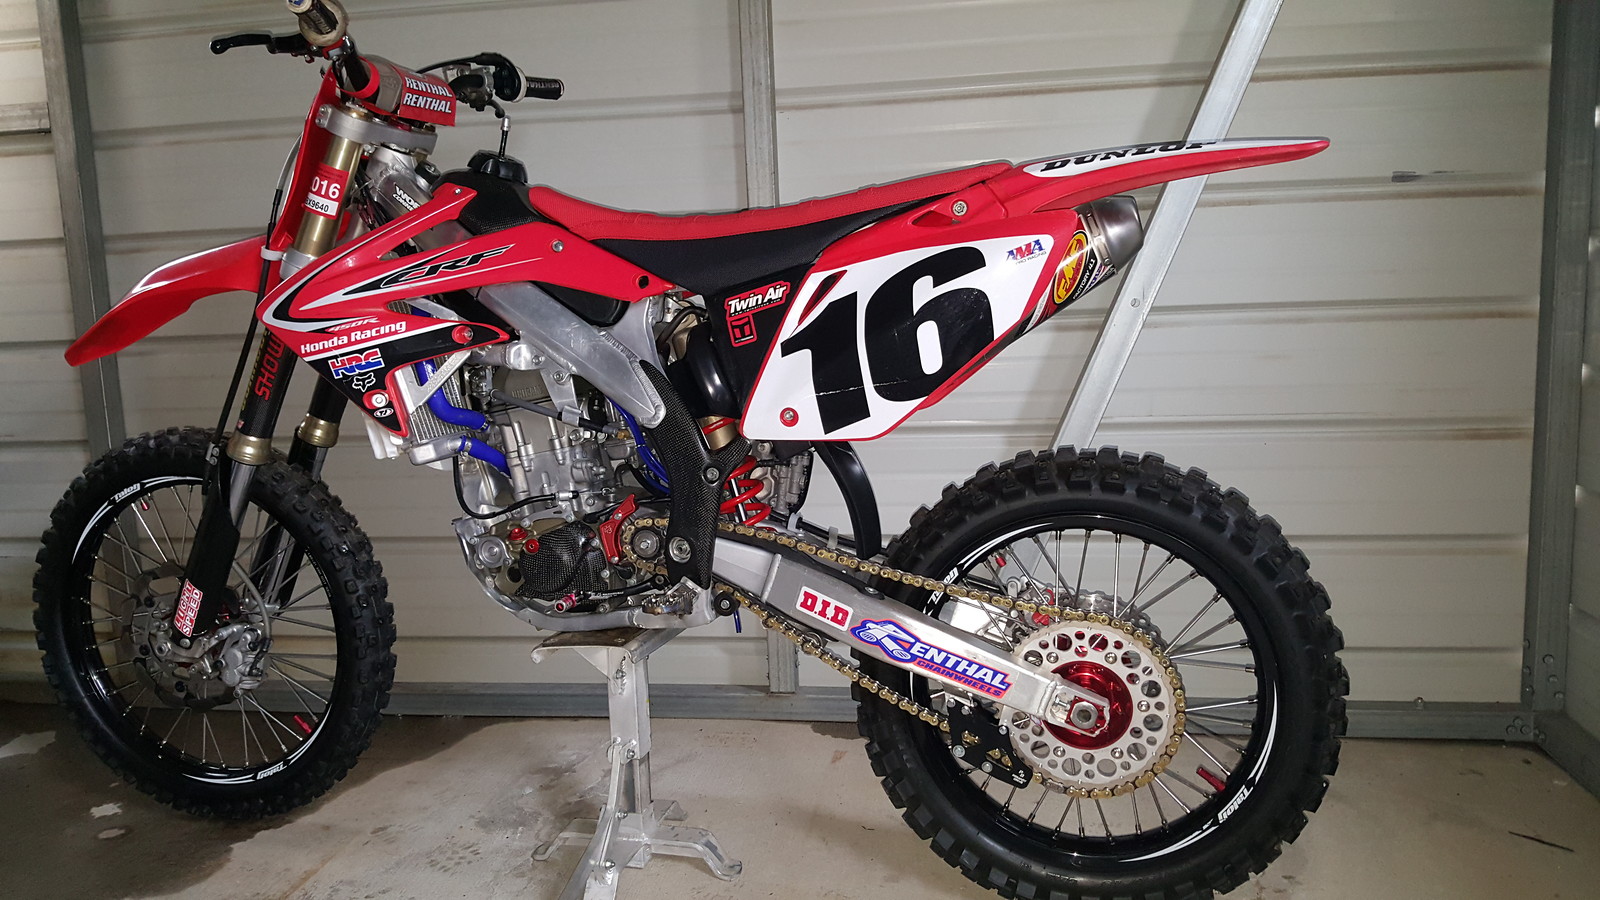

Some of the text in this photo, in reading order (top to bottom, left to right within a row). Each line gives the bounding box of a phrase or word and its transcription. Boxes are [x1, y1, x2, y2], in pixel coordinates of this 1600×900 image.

[403, 92, 452, 114] RENTHAL
[404, 76, 453, 98] RENTHAL
[380, 243, 515, 289] CRF
[1006, 239, 1045, 261] AMA
[728, 285, 787, 314] Twin Air
[301, 321, 407, 354] Honda Racing
[780, 246, 994, 435] 16
[328, 348, 386, 379] HRC
[182, 590, 201, 635] SPEED
[916, 660, 1003, 697] CHAINWHEELS
